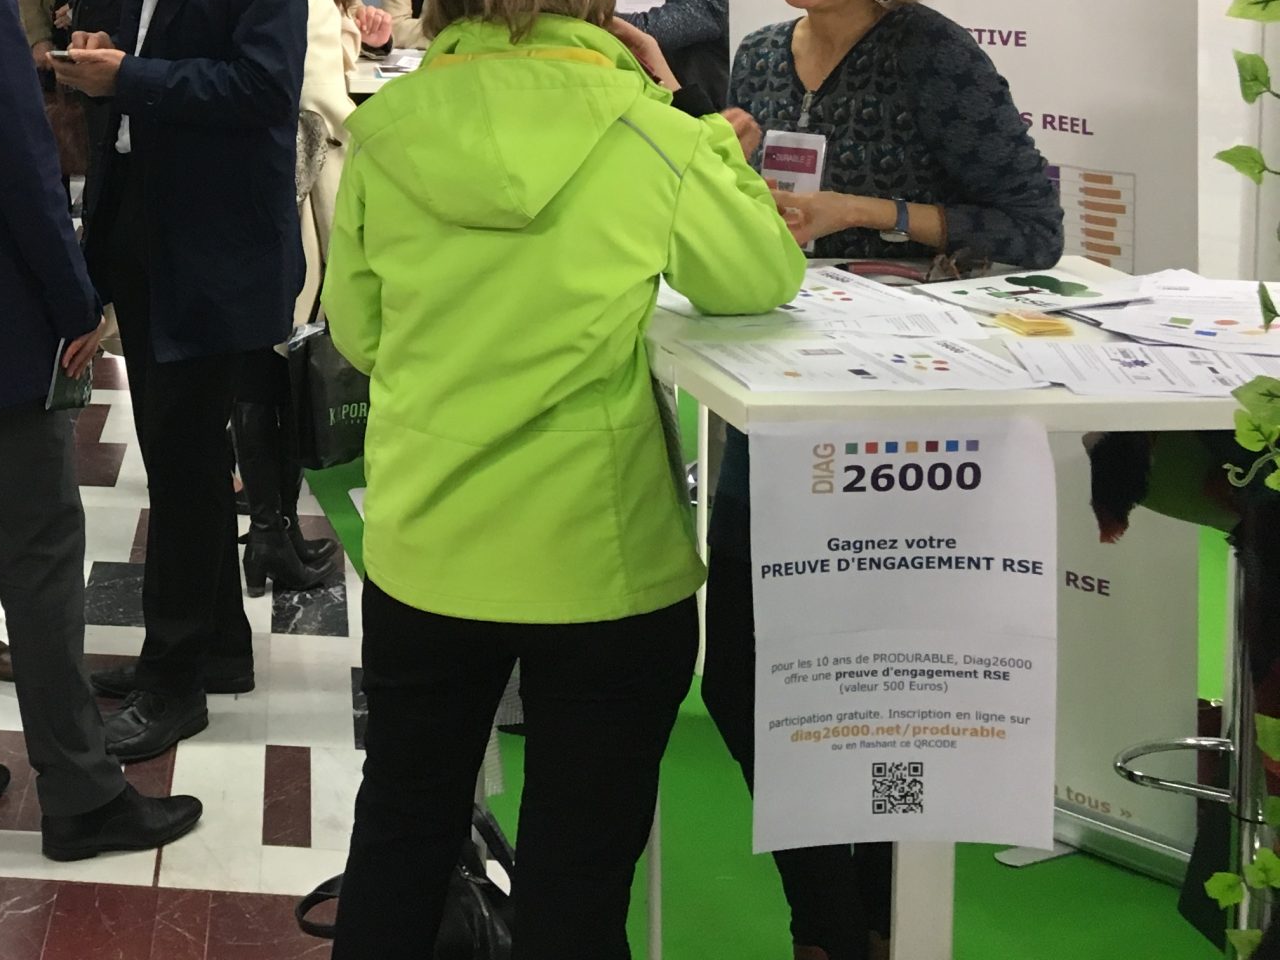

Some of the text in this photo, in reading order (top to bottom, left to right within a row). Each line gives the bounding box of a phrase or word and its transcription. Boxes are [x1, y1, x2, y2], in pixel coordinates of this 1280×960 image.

[965, 28, 1027, 47] TIVE
[1020, 112, 1094, 136] S REEL
[811, 442, 836, 494] DIAG
[842, 461, 982, 493] 26000
[827, 535, 957, 553] Gagnez votre
[761, 556, 1044, 579] PREUVE D'ENGAGEMENT RSE
[1064, 570, 1111, 596] RSE
[771, 652, 1033, 675] pour les 10 ans de PRODURABLE, Diag26000
[784, 666, 1011, 685] offre une preuve d'engagement RSE
[839, 681, 949, 694] (valeur 500 Euros)
[769, 708, 1031, 731] participation gratuite. Inscription en ligne sur
[790, 723, 1007, 743] diag26000.net/produrable
[831, 739, 957, 751] ou en flashant ce QRCODE
[1066, 785, 1111, 814] tous
